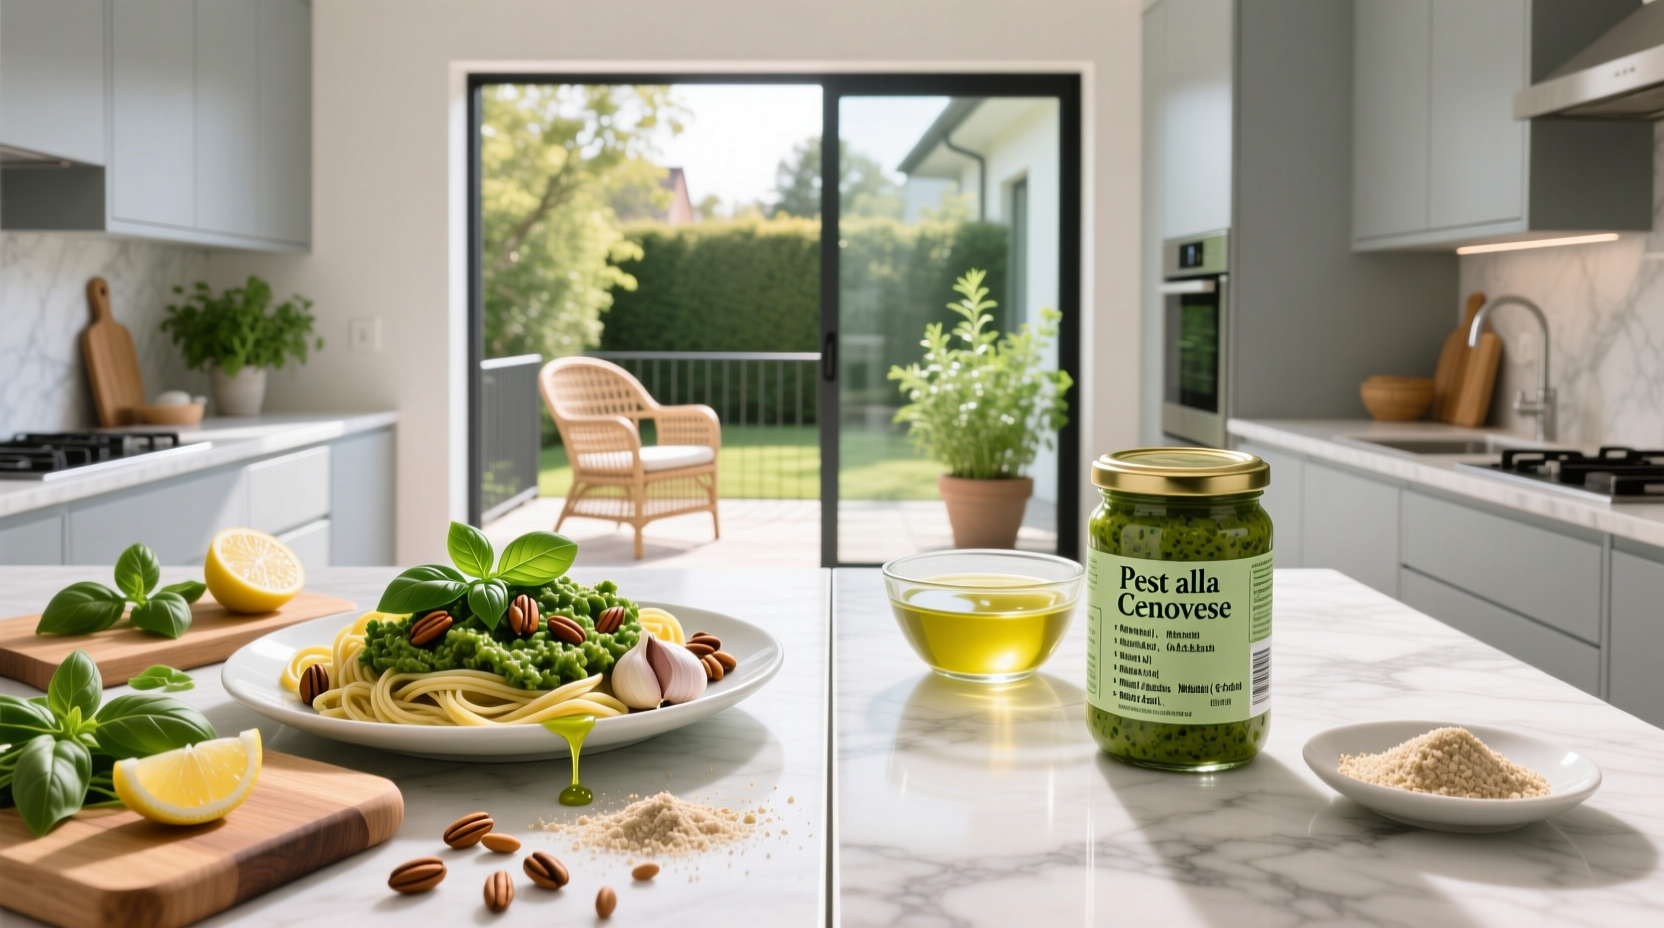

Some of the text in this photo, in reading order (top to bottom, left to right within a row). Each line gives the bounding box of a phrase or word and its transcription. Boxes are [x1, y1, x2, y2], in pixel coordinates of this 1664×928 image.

[1119, 565, 1169, 593] Pest
[1176, 569, 1220, 594] alla
[1118, 593, 1231, 619] Cenovese
